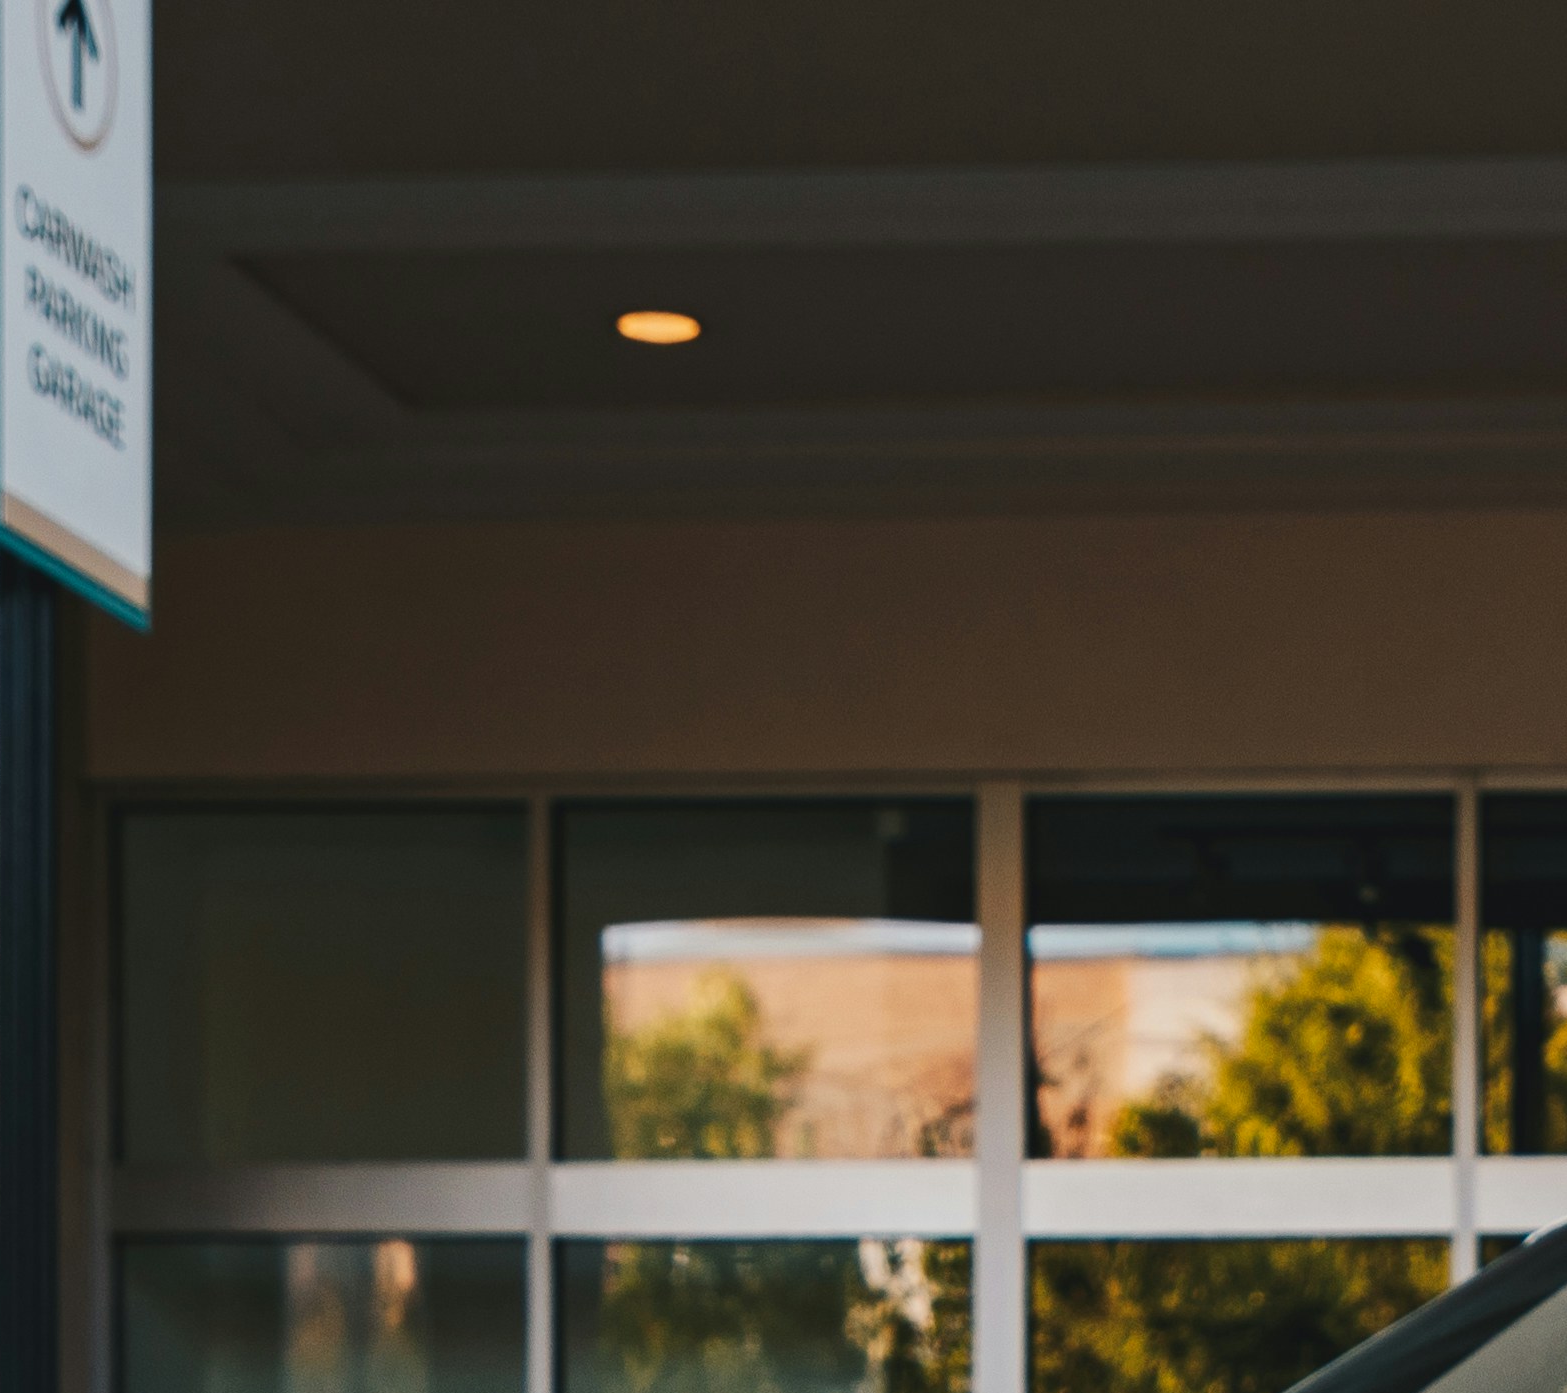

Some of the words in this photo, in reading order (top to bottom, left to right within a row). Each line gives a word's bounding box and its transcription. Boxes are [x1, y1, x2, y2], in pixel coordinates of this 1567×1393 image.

[15, 183, 136, 313] CARWASH
[25, 264, 129, 381] PARKING
[27, 342, 126, 451] GARAGE
